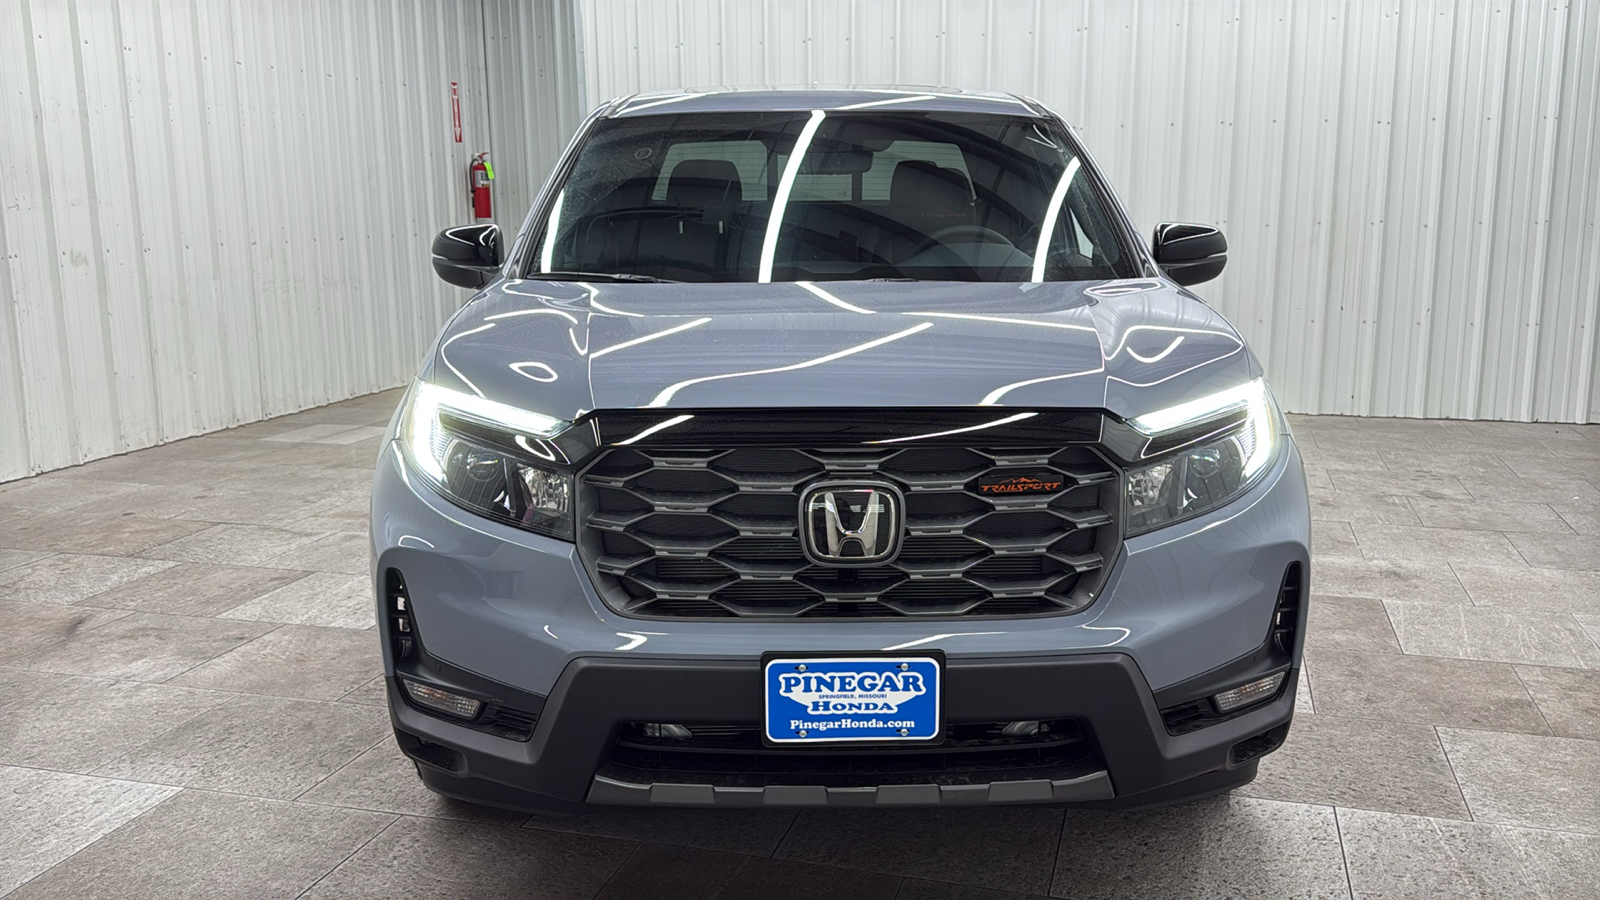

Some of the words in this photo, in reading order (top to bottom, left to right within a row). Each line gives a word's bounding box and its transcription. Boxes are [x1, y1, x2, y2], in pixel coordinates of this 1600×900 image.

[981, 482, 1061, 493] TRAILSPORT
[781, 674, 924, 694] PINEGAR
[810, 701, 895, 712] HONDA
[789, 719, 916, 731] PinegarHonda.com
